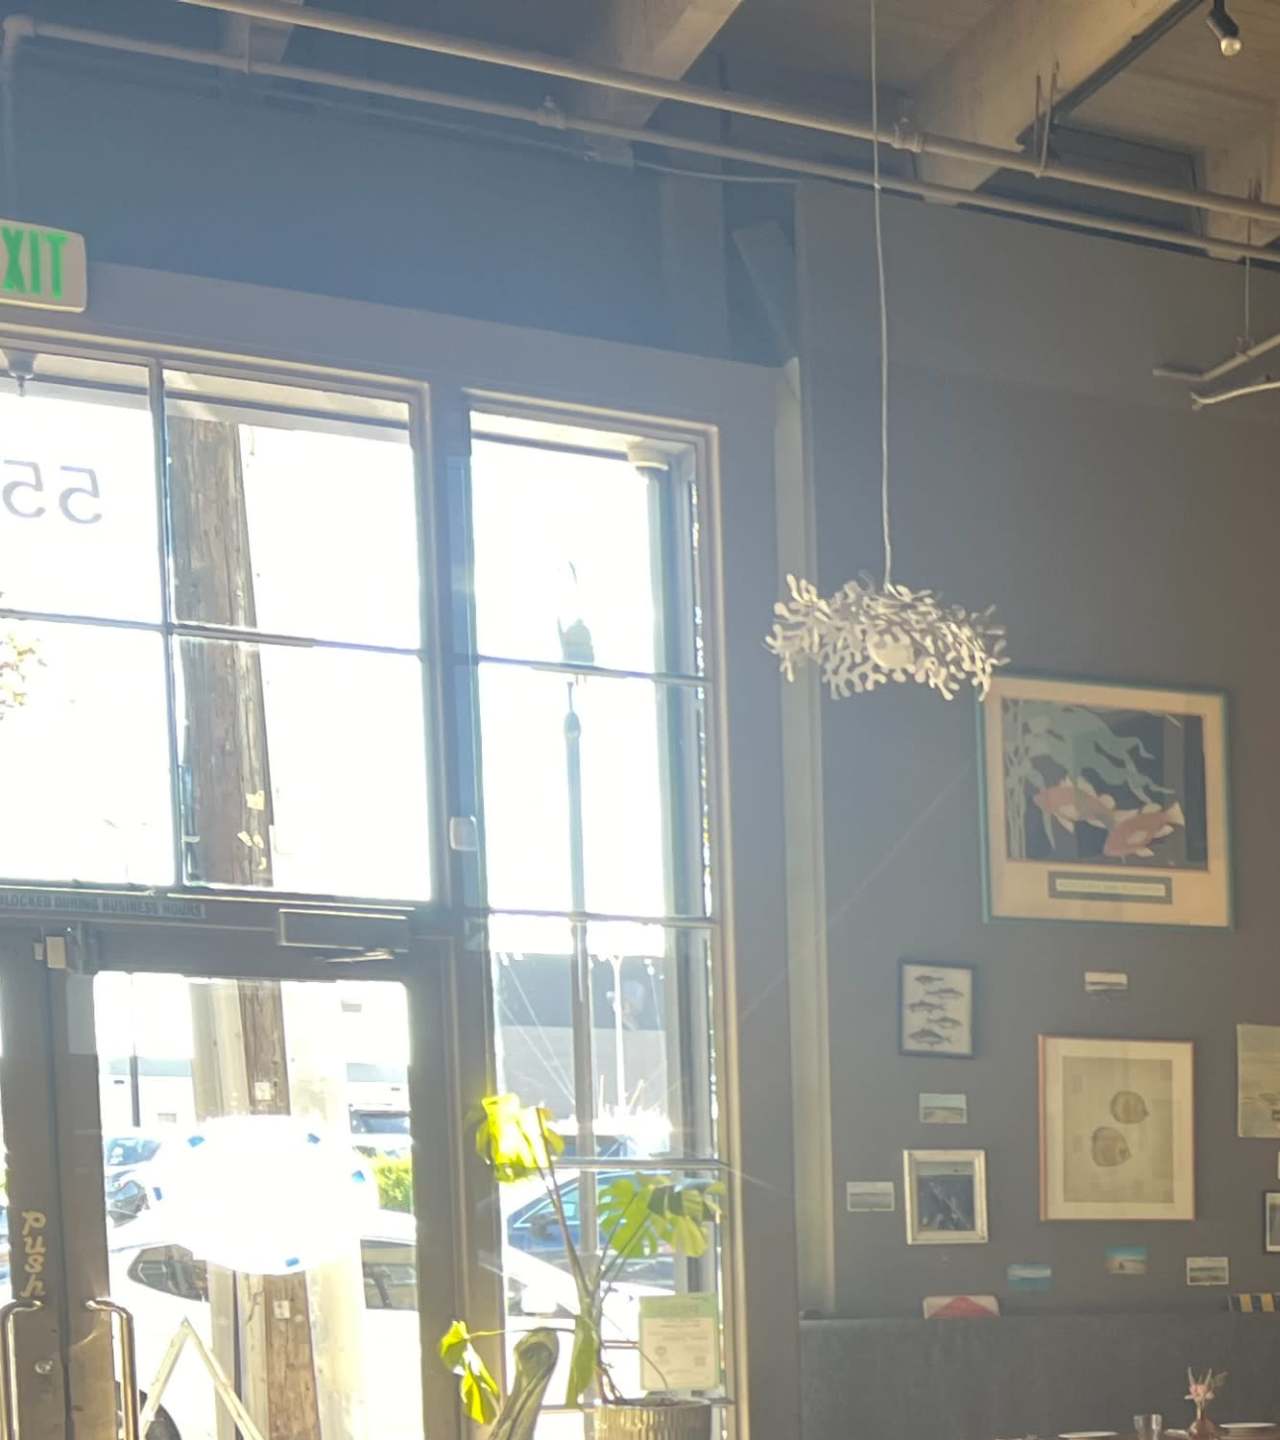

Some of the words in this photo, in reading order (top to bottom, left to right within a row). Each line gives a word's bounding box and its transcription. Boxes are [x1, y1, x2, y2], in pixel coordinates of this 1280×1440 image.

[0, 225, 70, 300] XIT
[54, 896, 98, 910] DURING
[102, 898, 159, 914] BUSINESS
[162, 903, 201, 916] HOURS
